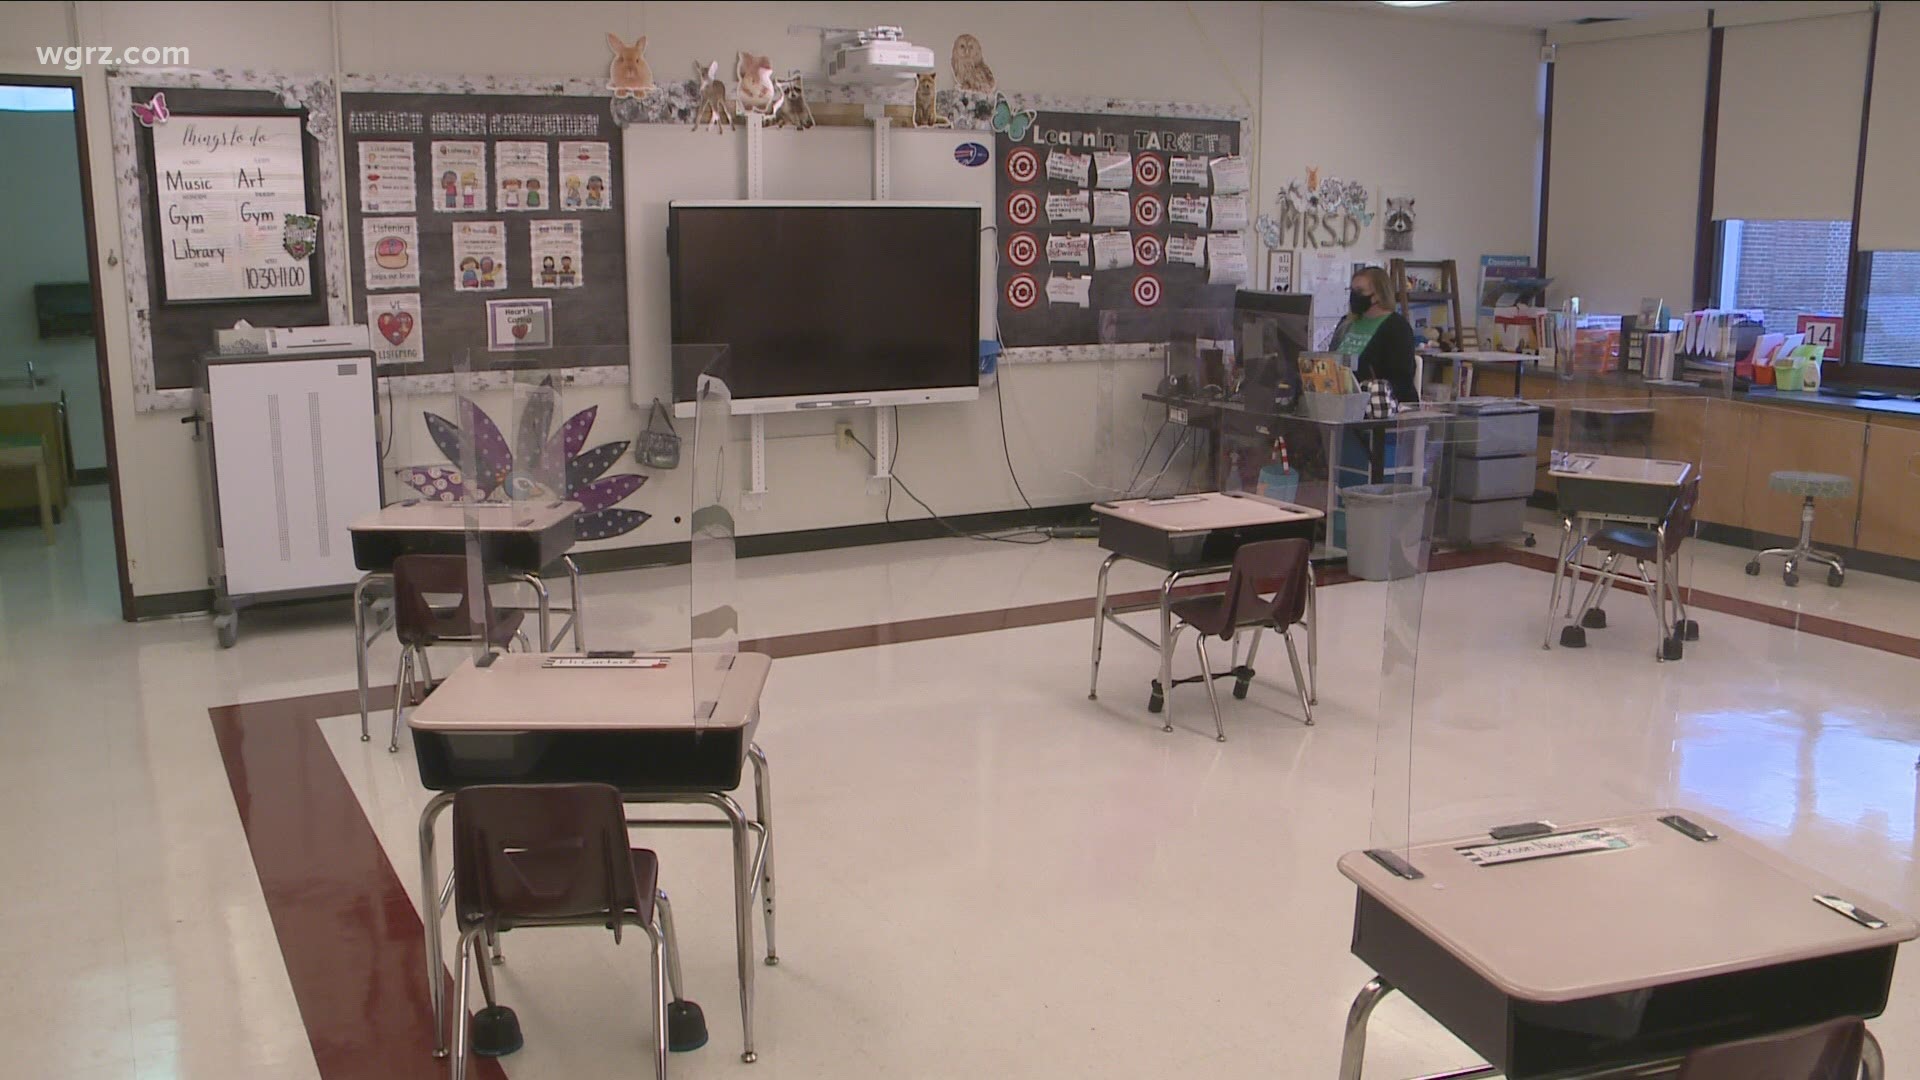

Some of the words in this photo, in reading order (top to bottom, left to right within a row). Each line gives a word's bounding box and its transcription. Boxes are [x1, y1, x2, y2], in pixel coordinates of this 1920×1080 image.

[166, 170, 213, 191] Music
[238, 167, 265, 189] Art
[169, 204, 204, 231] Gym
[240, 201, 274, 226] Gym
[373, 223, 411, 235] Listening
[171, 238, 226, 264] Library
[1050, 240, 1053, 248] I
[505, 308, 526, 316] Heart
[527, 308, 534, 316] is
[1807, 324, 1833, 347] 14
[378, 348, 418, 360] LISTENING
